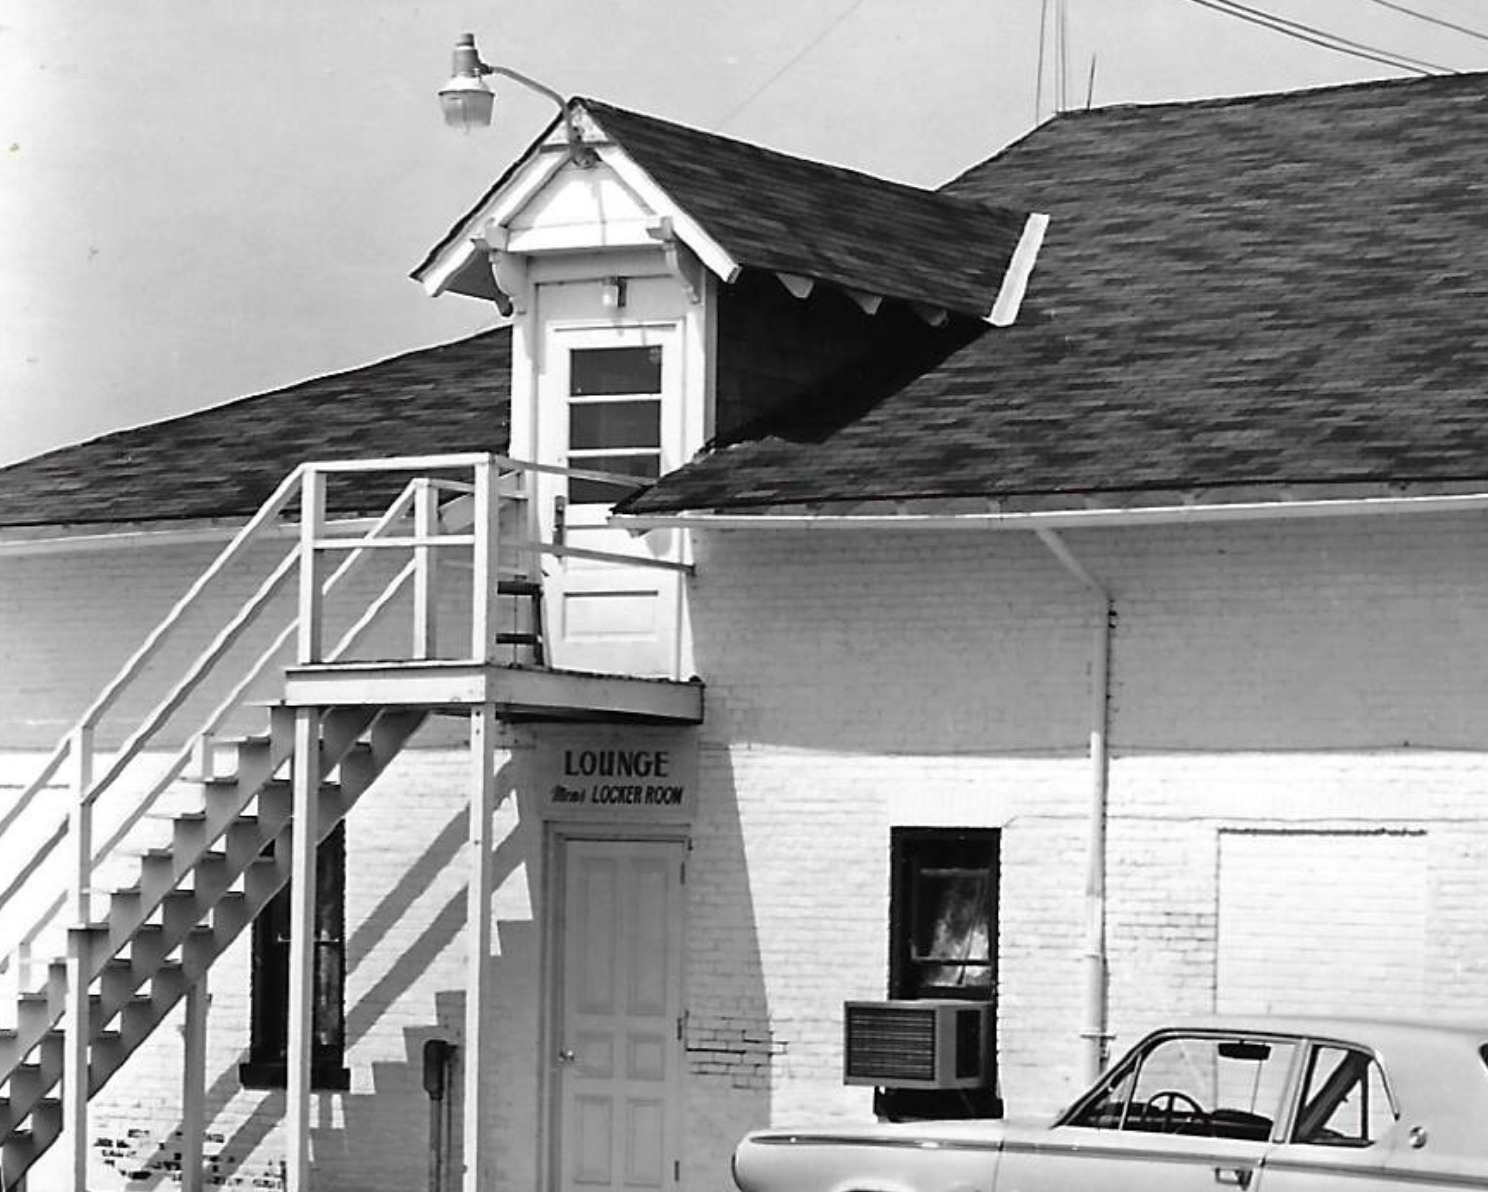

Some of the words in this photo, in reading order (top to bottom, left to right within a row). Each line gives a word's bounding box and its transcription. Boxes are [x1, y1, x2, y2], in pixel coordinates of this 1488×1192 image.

[564, 751, 670, 777] LOUNGE
[592, 785, 643, 804] LOCKER
[645, 786, 684, 805] ROOM
